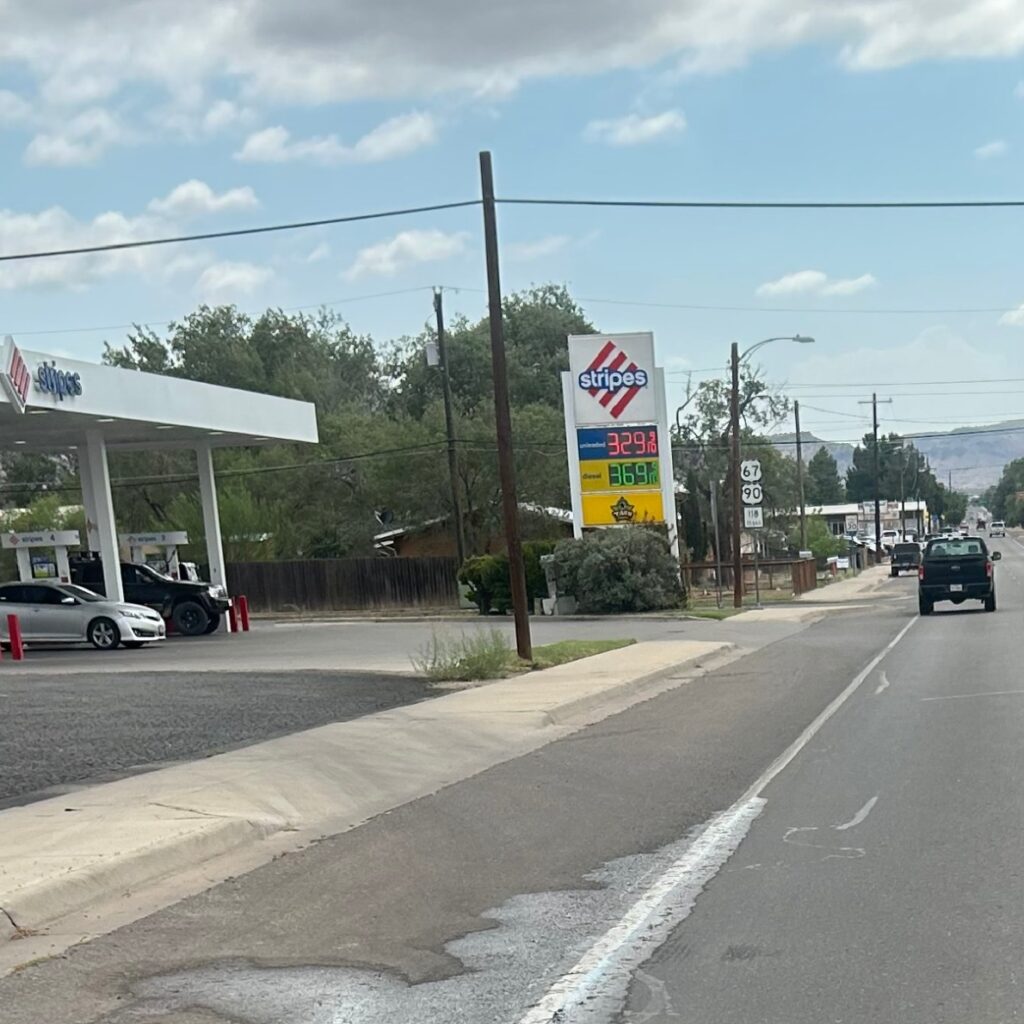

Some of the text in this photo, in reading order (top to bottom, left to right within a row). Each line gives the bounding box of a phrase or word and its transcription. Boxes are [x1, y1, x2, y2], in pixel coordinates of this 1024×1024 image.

[580, 368, 647, 392] stripes
[608, 431, 646, 455] 329
[610, 463, 647, 487] 369
[743, 464, 759, 478] 67
[744, 487, 761, 499] 90
